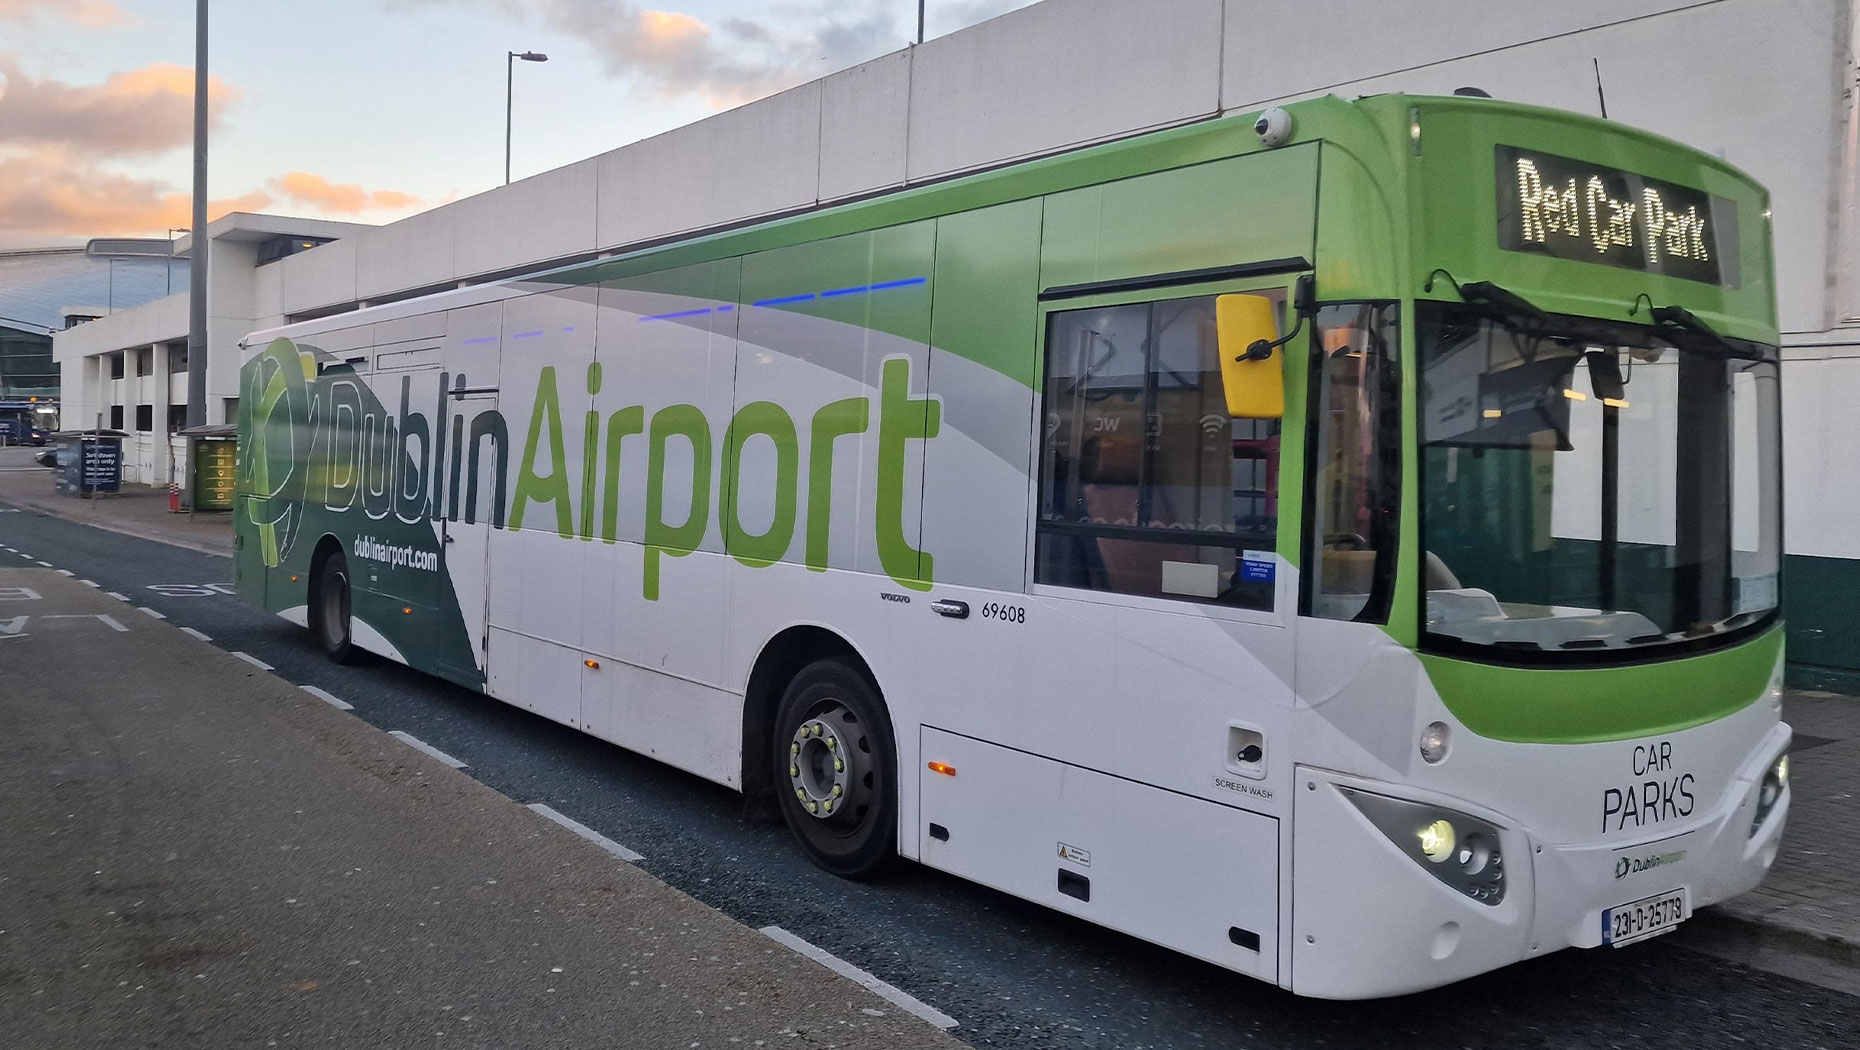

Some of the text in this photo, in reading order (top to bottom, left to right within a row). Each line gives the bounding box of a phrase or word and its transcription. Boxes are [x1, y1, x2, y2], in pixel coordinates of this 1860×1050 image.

[1517, 157, 1709, 263] Red Car Park
[354, 533, 438, 572] dublinairport.com
[880, 592, 911, 604] VOLVO
[982, 602, 1025, 624] 69608
[1633, 741, 1672, 777] CAR
[1215, 778, 1273, 799] SCREEN WASH
[1602, 773, 1695, 834] PARKS
